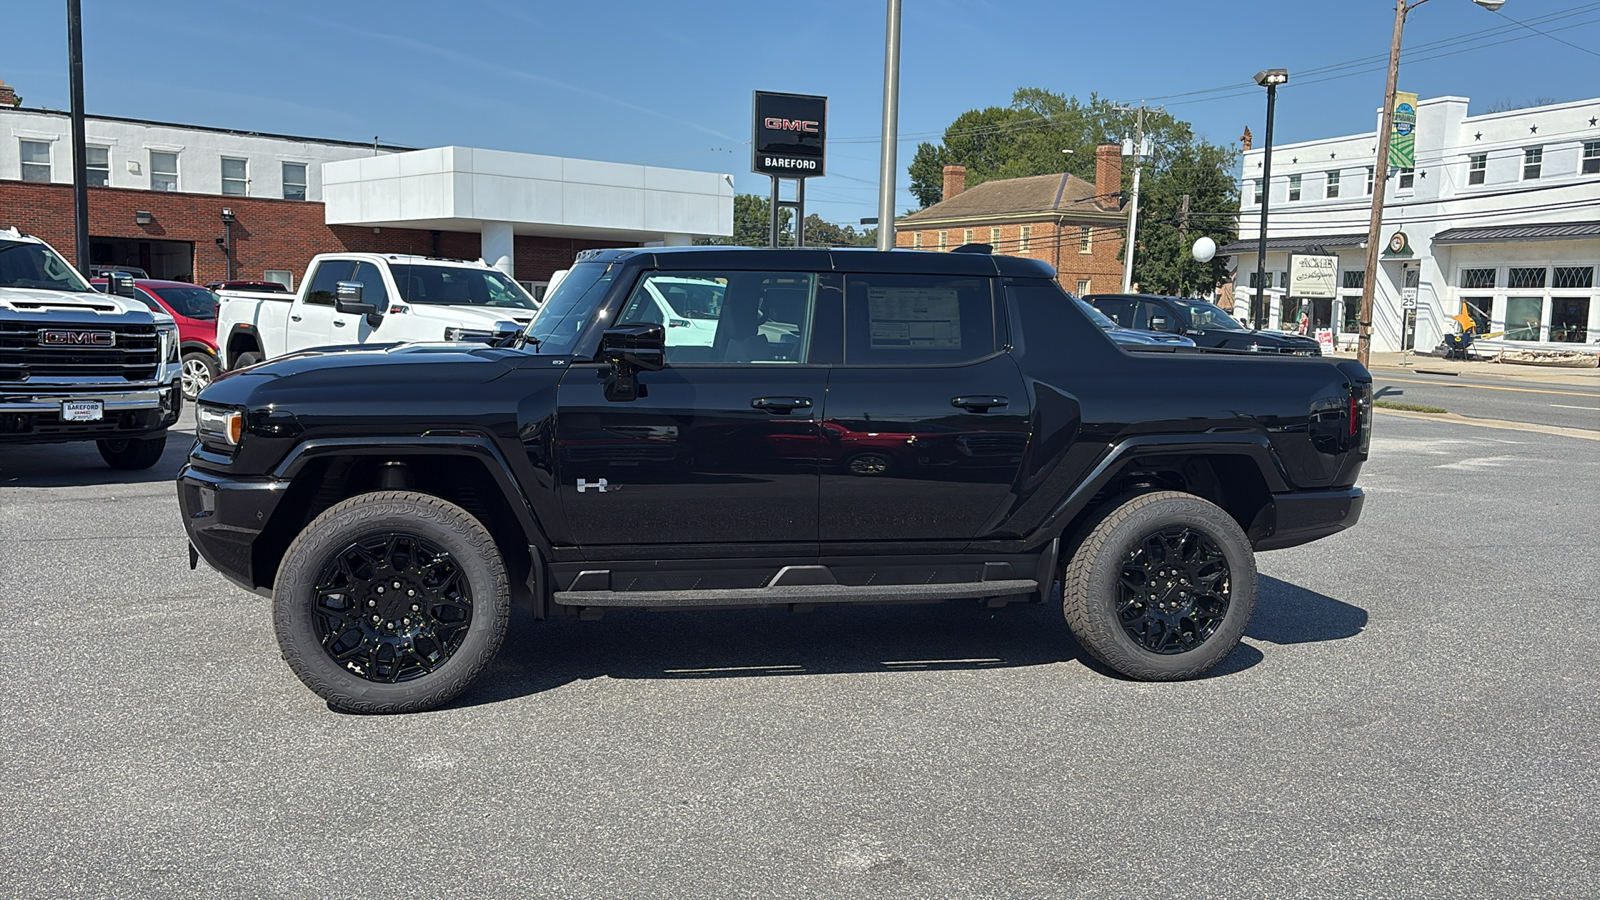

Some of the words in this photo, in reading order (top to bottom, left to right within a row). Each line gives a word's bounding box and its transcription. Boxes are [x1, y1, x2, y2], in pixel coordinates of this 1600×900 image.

[764, 117, 819, 133] GMC
[764, 157, 817, 170] BAREFORD
[1402, 297, 1415, 306] 25
[45, 331, 111, 345] GMC
